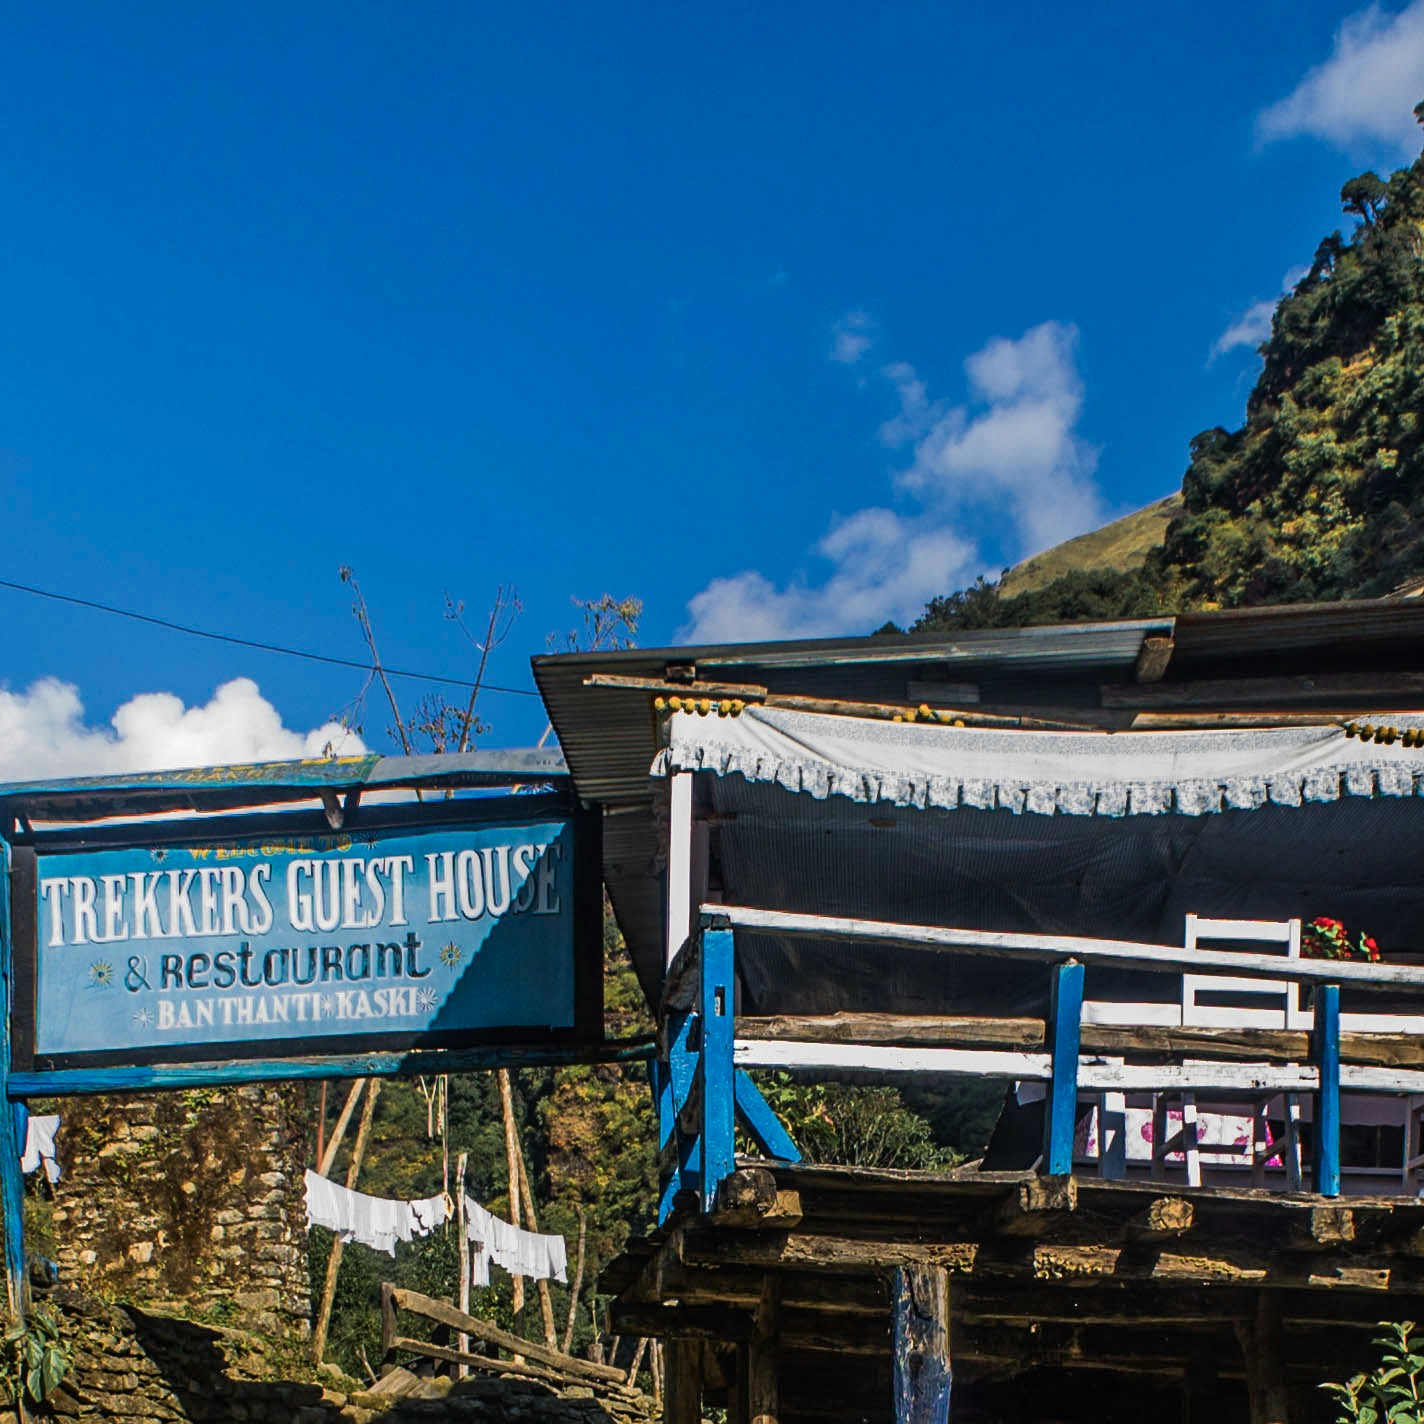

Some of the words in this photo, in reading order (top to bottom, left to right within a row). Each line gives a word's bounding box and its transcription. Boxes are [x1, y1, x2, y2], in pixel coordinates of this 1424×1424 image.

[40, 863, 275, 948] TREKKERS
[286, 855, 416, 933] GUEST
[424, 842, 563, 922] HOUSE
[125, 955, 153, 993] &
[335, 986, 418, 1020] KASKI
